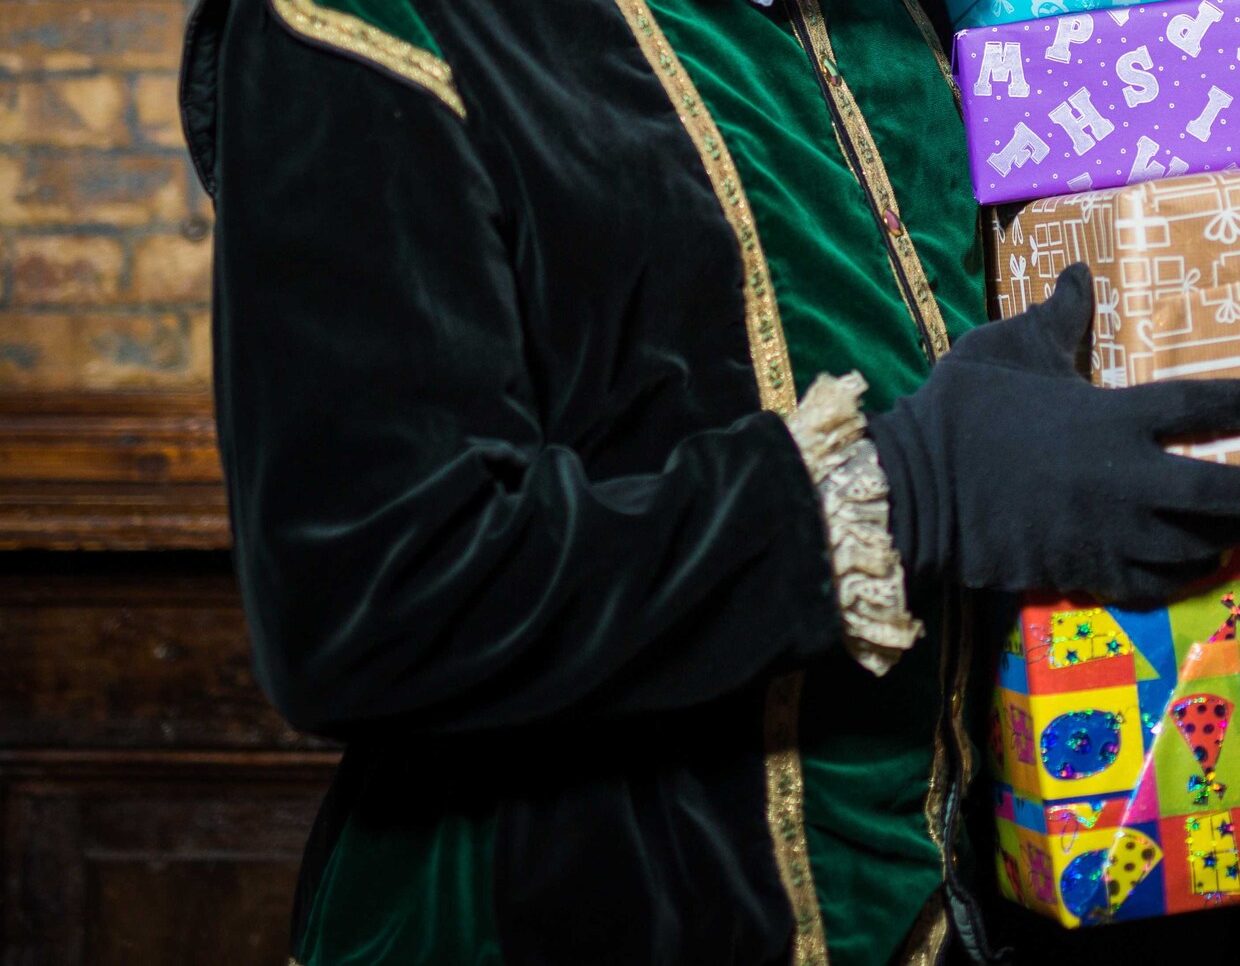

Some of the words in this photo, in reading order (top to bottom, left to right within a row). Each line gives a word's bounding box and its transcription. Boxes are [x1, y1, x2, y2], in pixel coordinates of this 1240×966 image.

[1045, 14, 1094, 64] P
[1166, 0, 1224, 58] P
[974, 42, 1030, 98] M
[1116, 45, 1159, 108] S
[1048, 86, 1115, 156] H
[1186, 85, 1234, 142] I
[987, 122, 1050, 178] F
